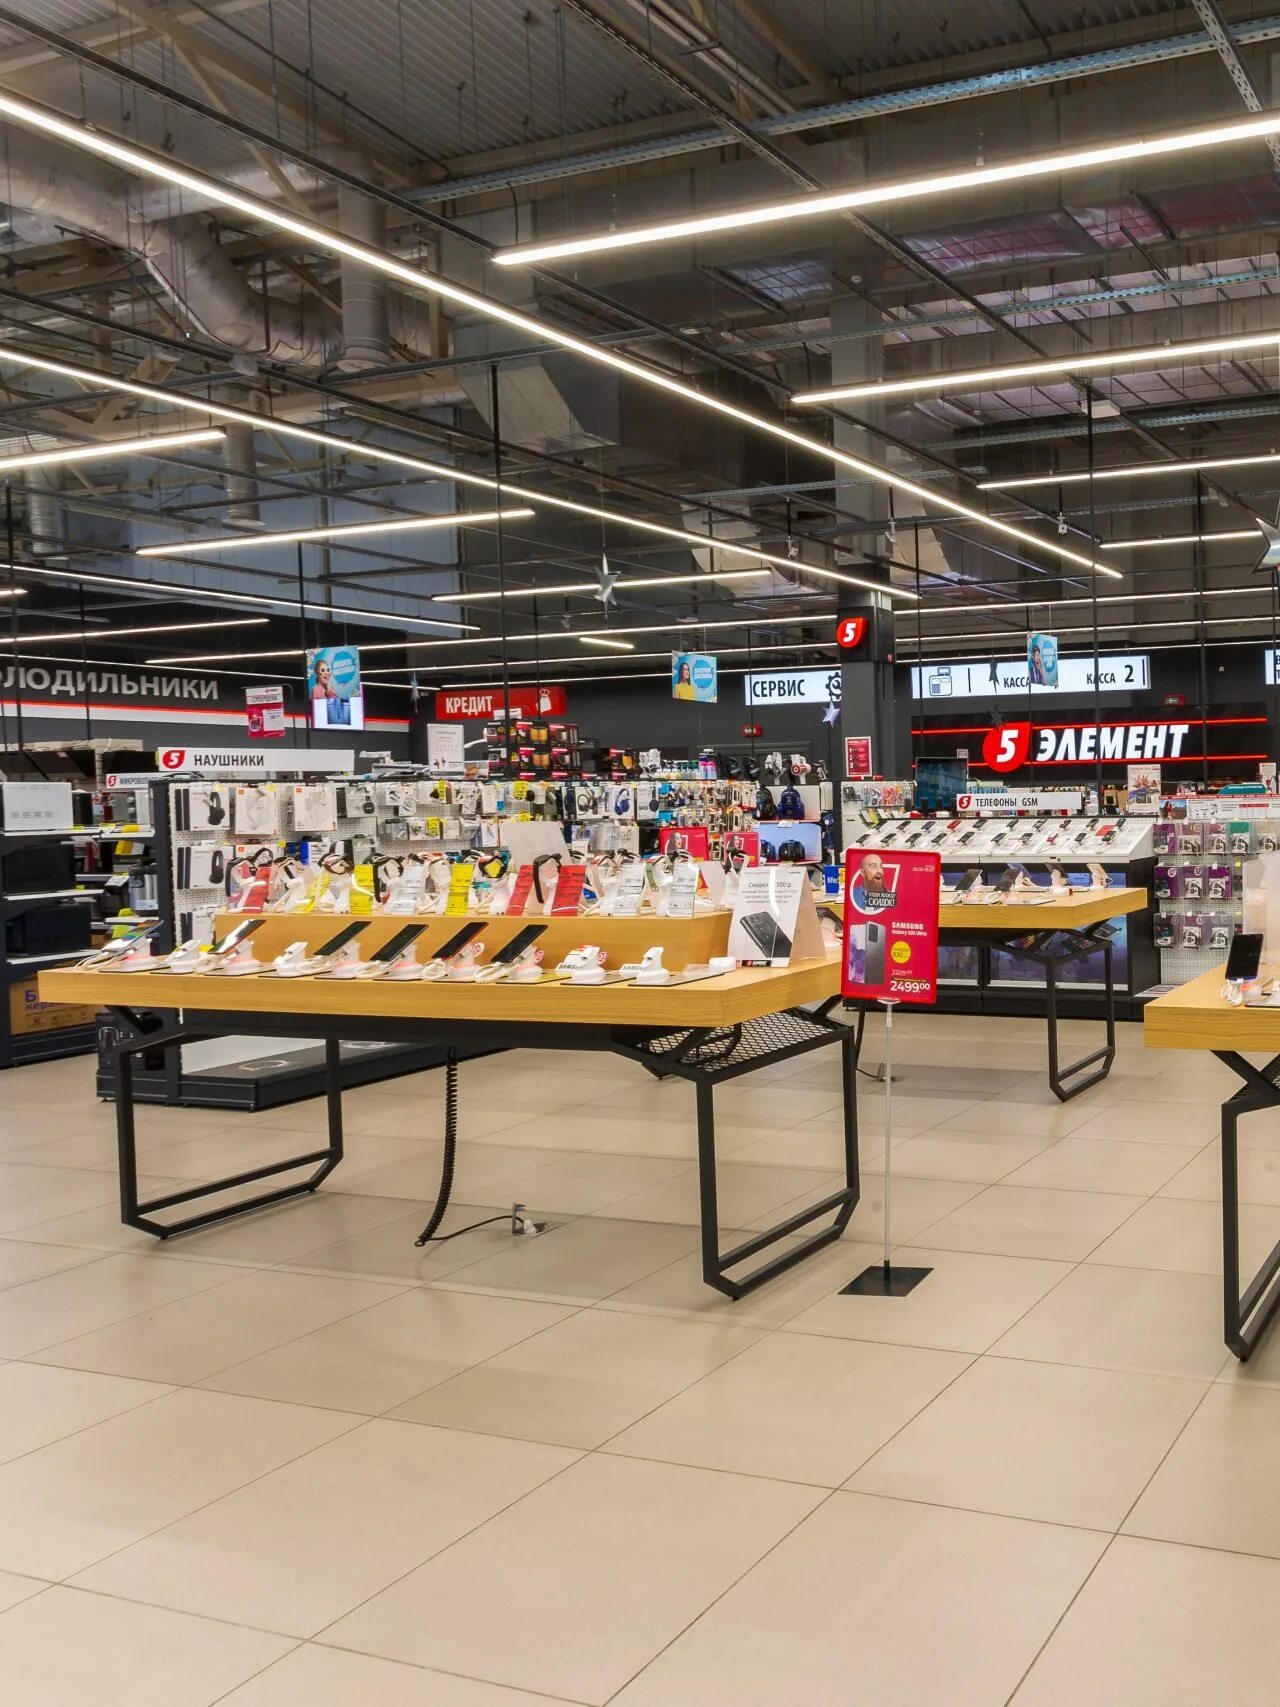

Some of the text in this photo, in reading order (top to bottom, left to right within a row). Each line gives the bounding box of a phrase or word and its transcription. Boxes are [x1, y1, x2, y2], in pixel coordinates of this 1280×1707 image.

[843, 622, 857, 642] 5
[0, 666, 219, 700] ЛОДИЛЬНИКИ
[1124, 664, 1135, 683] 2
[752, 679, 806, 698] СЕРВИС
[446, 696, 492, 716] КРЕДИТ
[996, 724, 1189, 762] 5 ЭЛЕМЕНТ
[168, 752, 264, 766] 5 НАУШНИКИ
[976, 798, 1017, 807] ТЕЛЕФОНЫ
[1022, 797, 1038, 806] GSM
[868, 898, 894, 906] СКИДОК!
[892, 922, 924, 930] SAMSUNG
